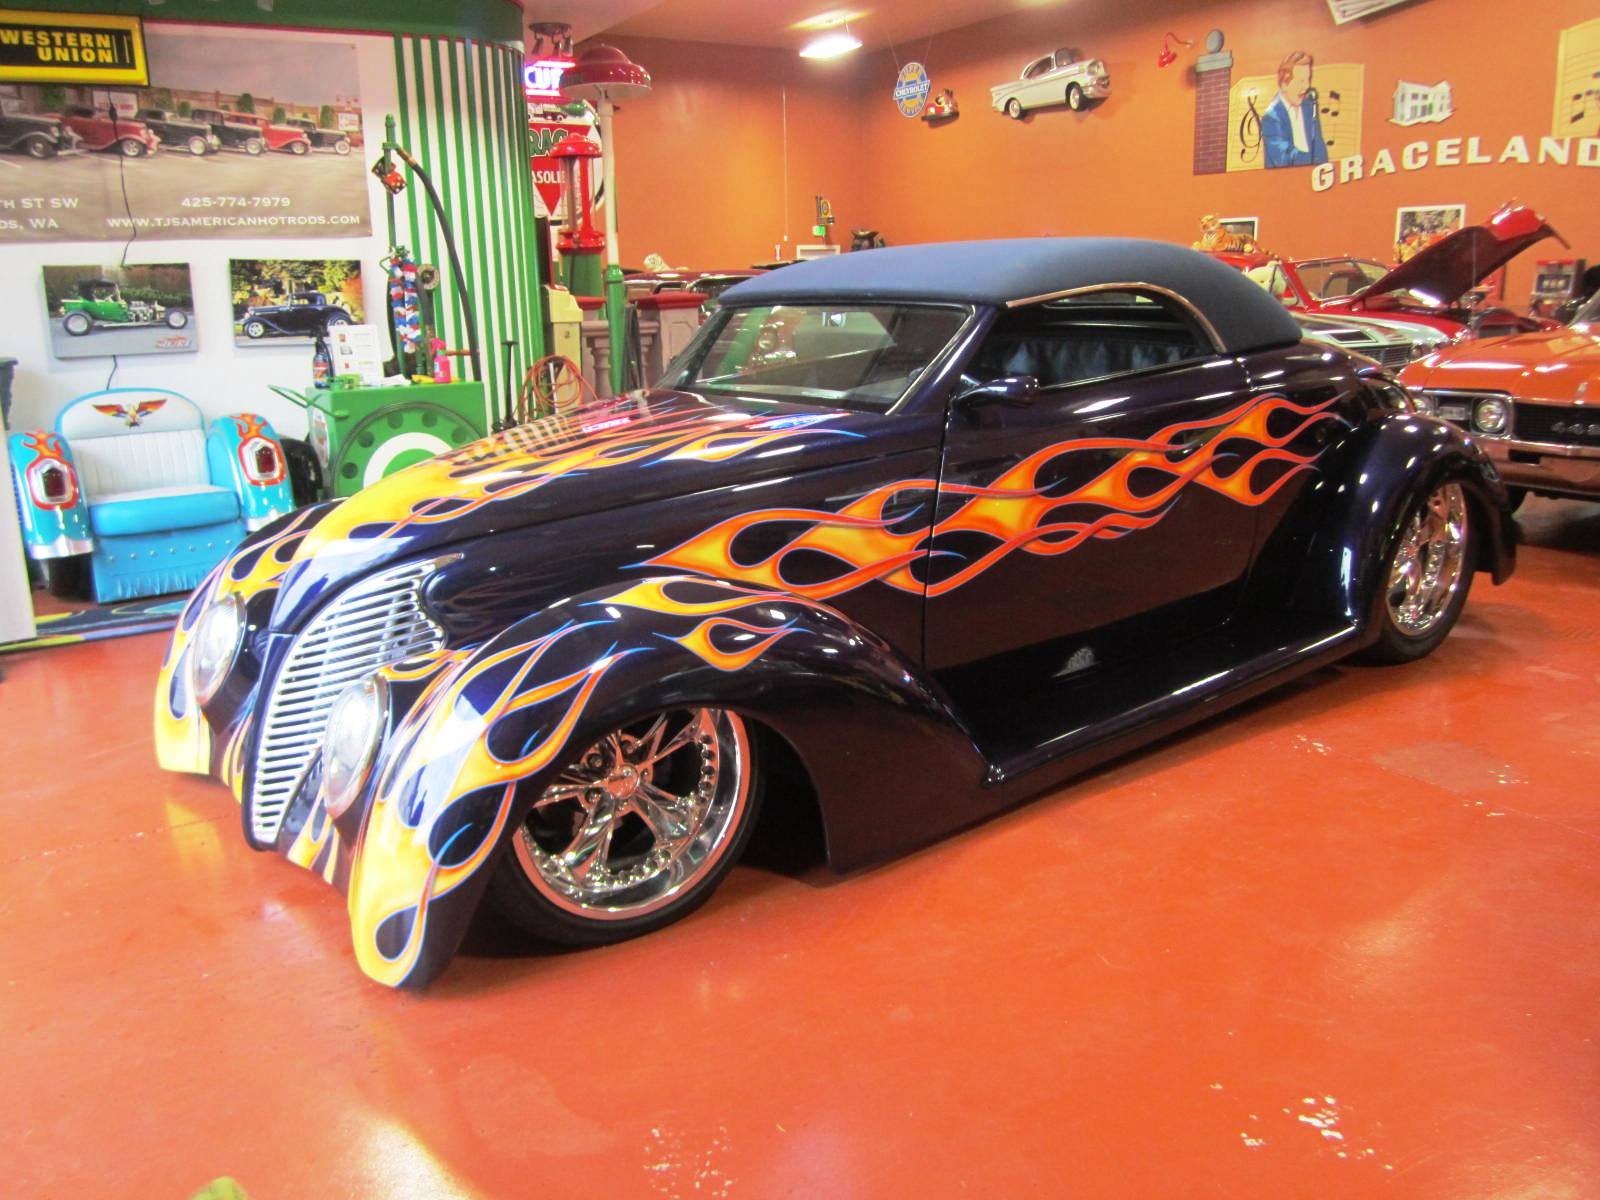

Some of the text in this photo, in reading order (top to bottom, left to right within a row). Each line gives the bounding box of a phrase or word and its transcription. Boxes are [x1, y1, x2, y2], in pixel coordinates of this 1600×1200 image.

[0, 29, 112, 48] WESTERN
[37, 46, 113, 63] UNION
[895, 83, 928, 97] CHEVROLET
[1311, 135, 1600, 192] GRACELAND
[21, 197, 45, 209] ST
[49, 197, 79, 209] SW
[181, 196, 291, 208] 425-774-7979
[29, 217, 60, 229] WA
[106, 215, 361, 228] WWW.TJSAMERICANHOTRODS.COM
